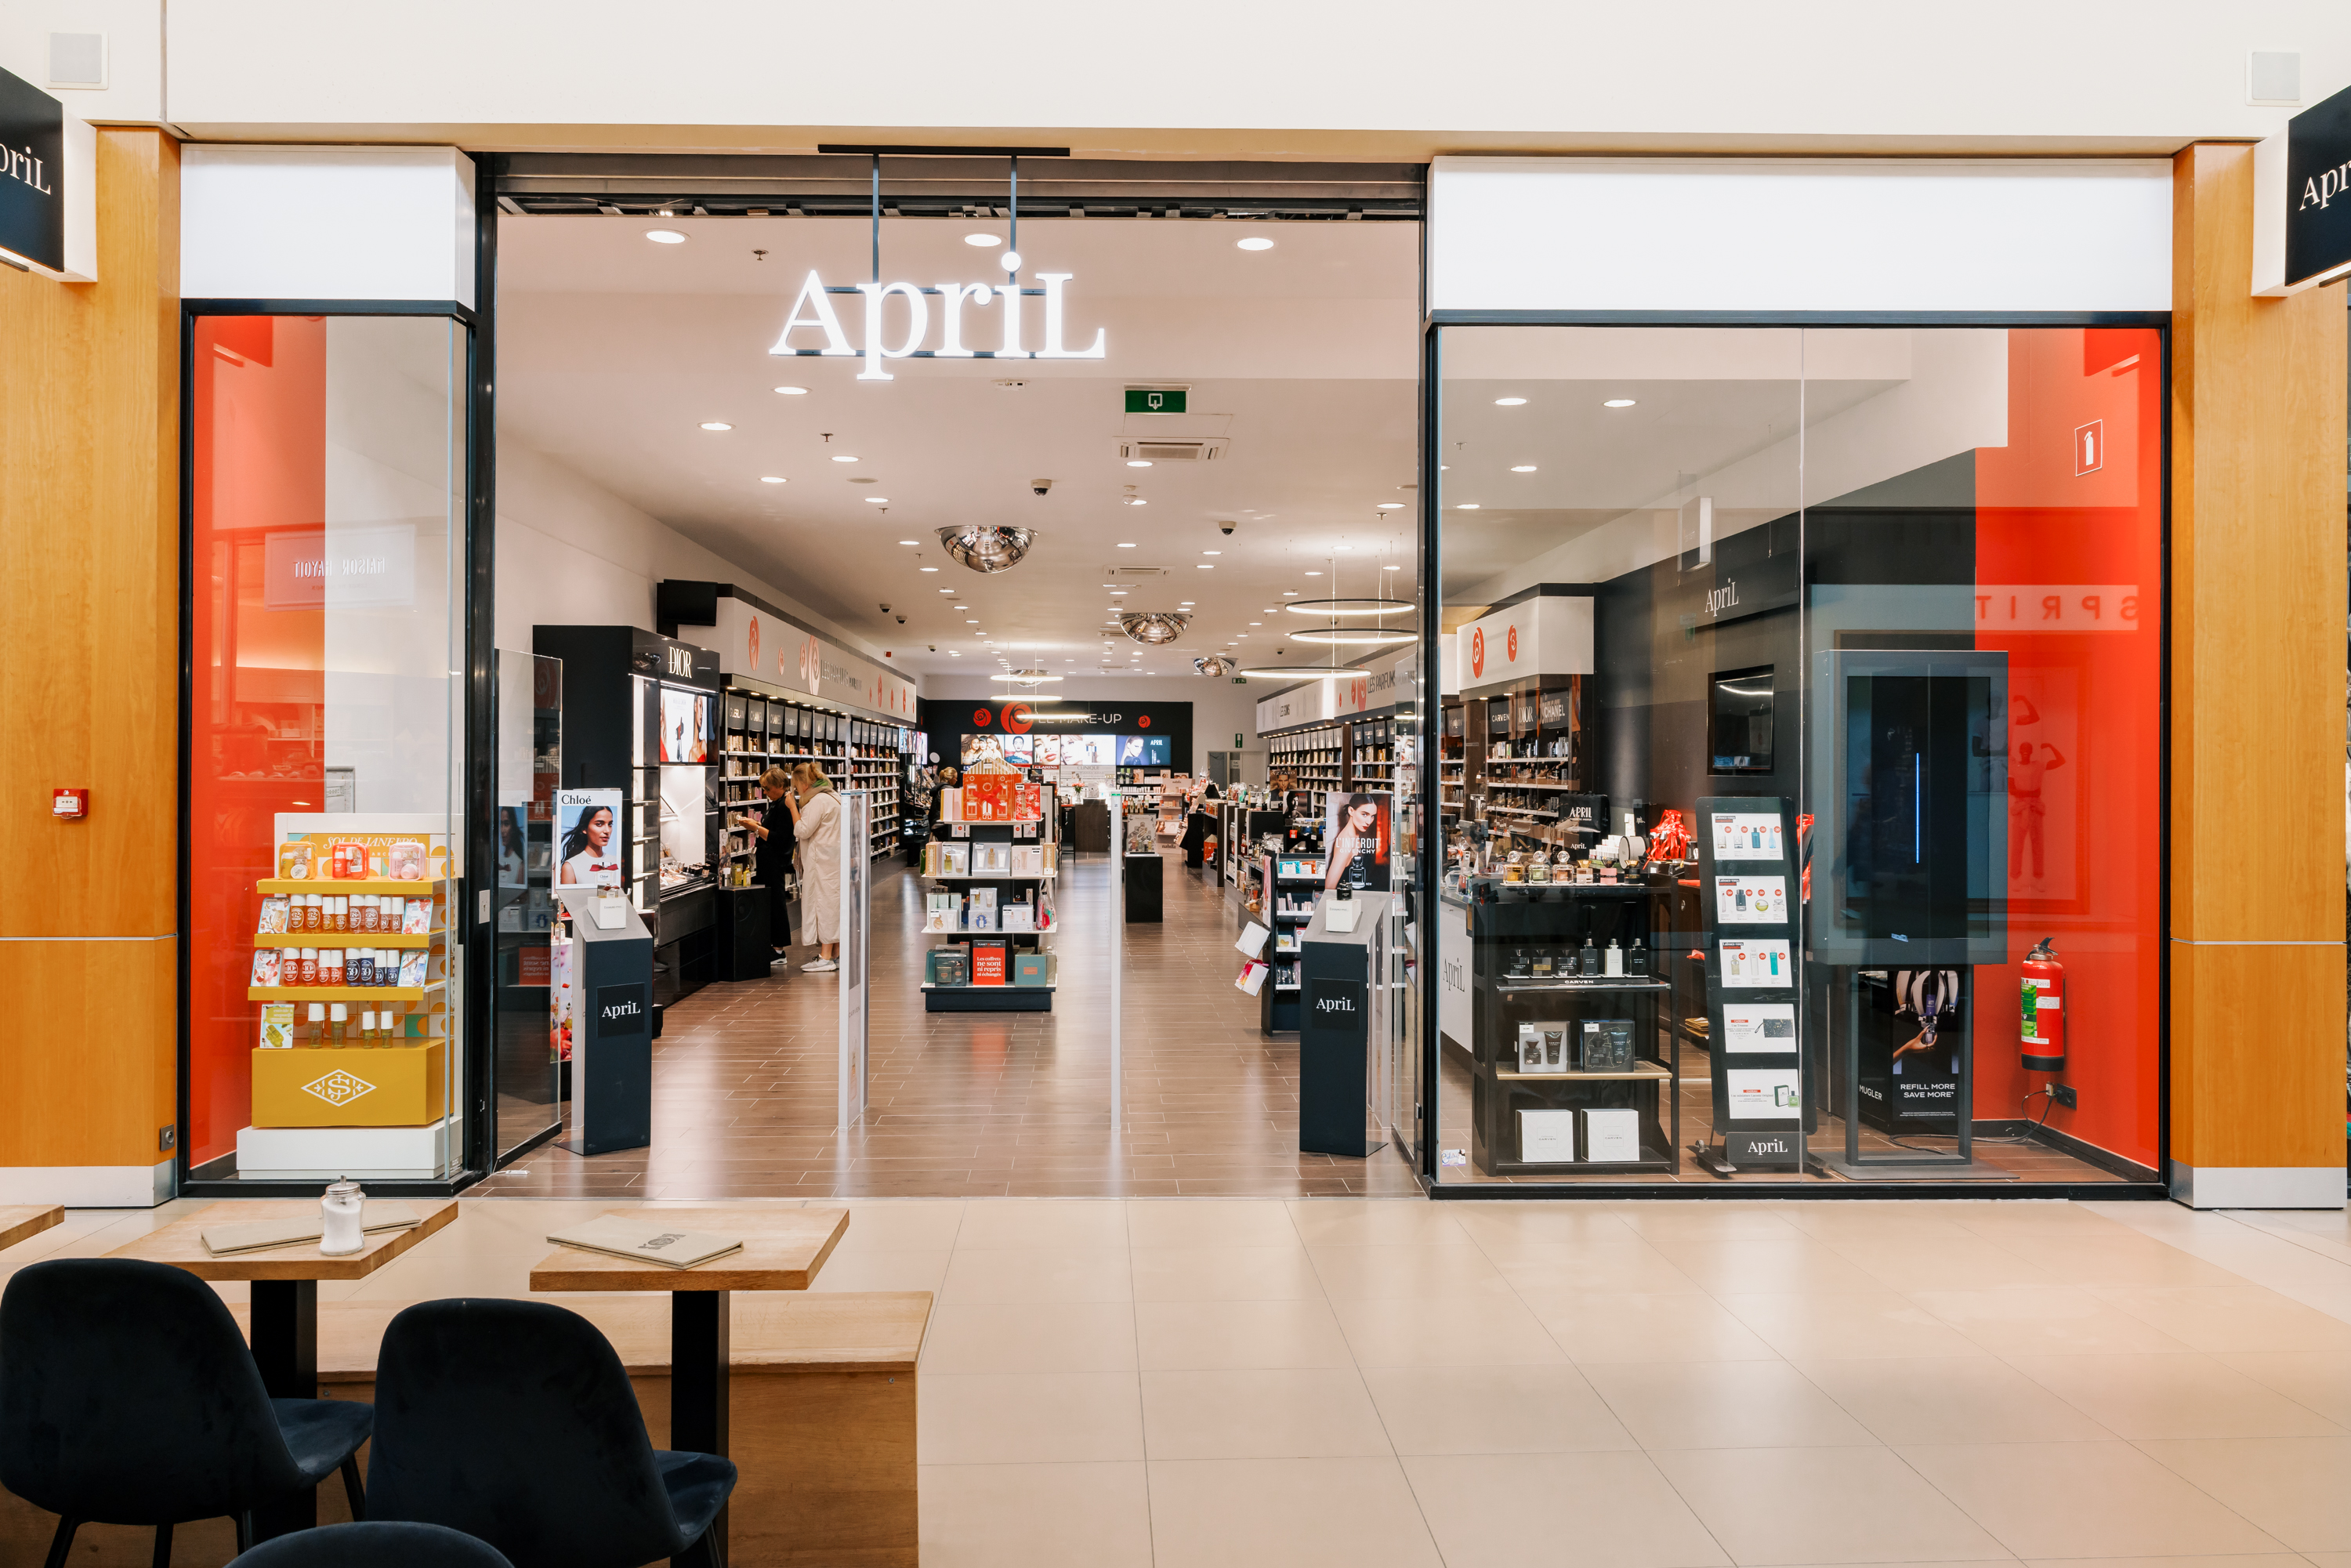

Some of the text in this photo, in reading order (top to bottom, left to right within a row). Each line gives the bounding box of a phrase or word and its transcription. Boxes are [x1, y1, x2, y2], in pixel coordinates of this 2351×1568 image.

[769, 252, 1105, 381] ApriL
[1704, 577, 1739, 617] ApriL
[668, 646, 692, 679] DIOR
[1492, 713, 1510, 722] CARVEN
[1519, 706, 1534, 723] DIOR
[1544, 704, 1566, 719] CHANEL
[561, 794, 592, 805] Chloé
[1570, 806, 1592, 818] APRIL
[1335, 837, 1380, 849] L'INTERDIT
[1443, 957, 1465, 992] ApriL
[601, 1000, 641, 1019] ApriL
[1316, 996, 1355, 1012] ApriL
[1859, 1085, 1882, 1101] MUGLER
[1748, 1138, 1788, 1156] ApriL
